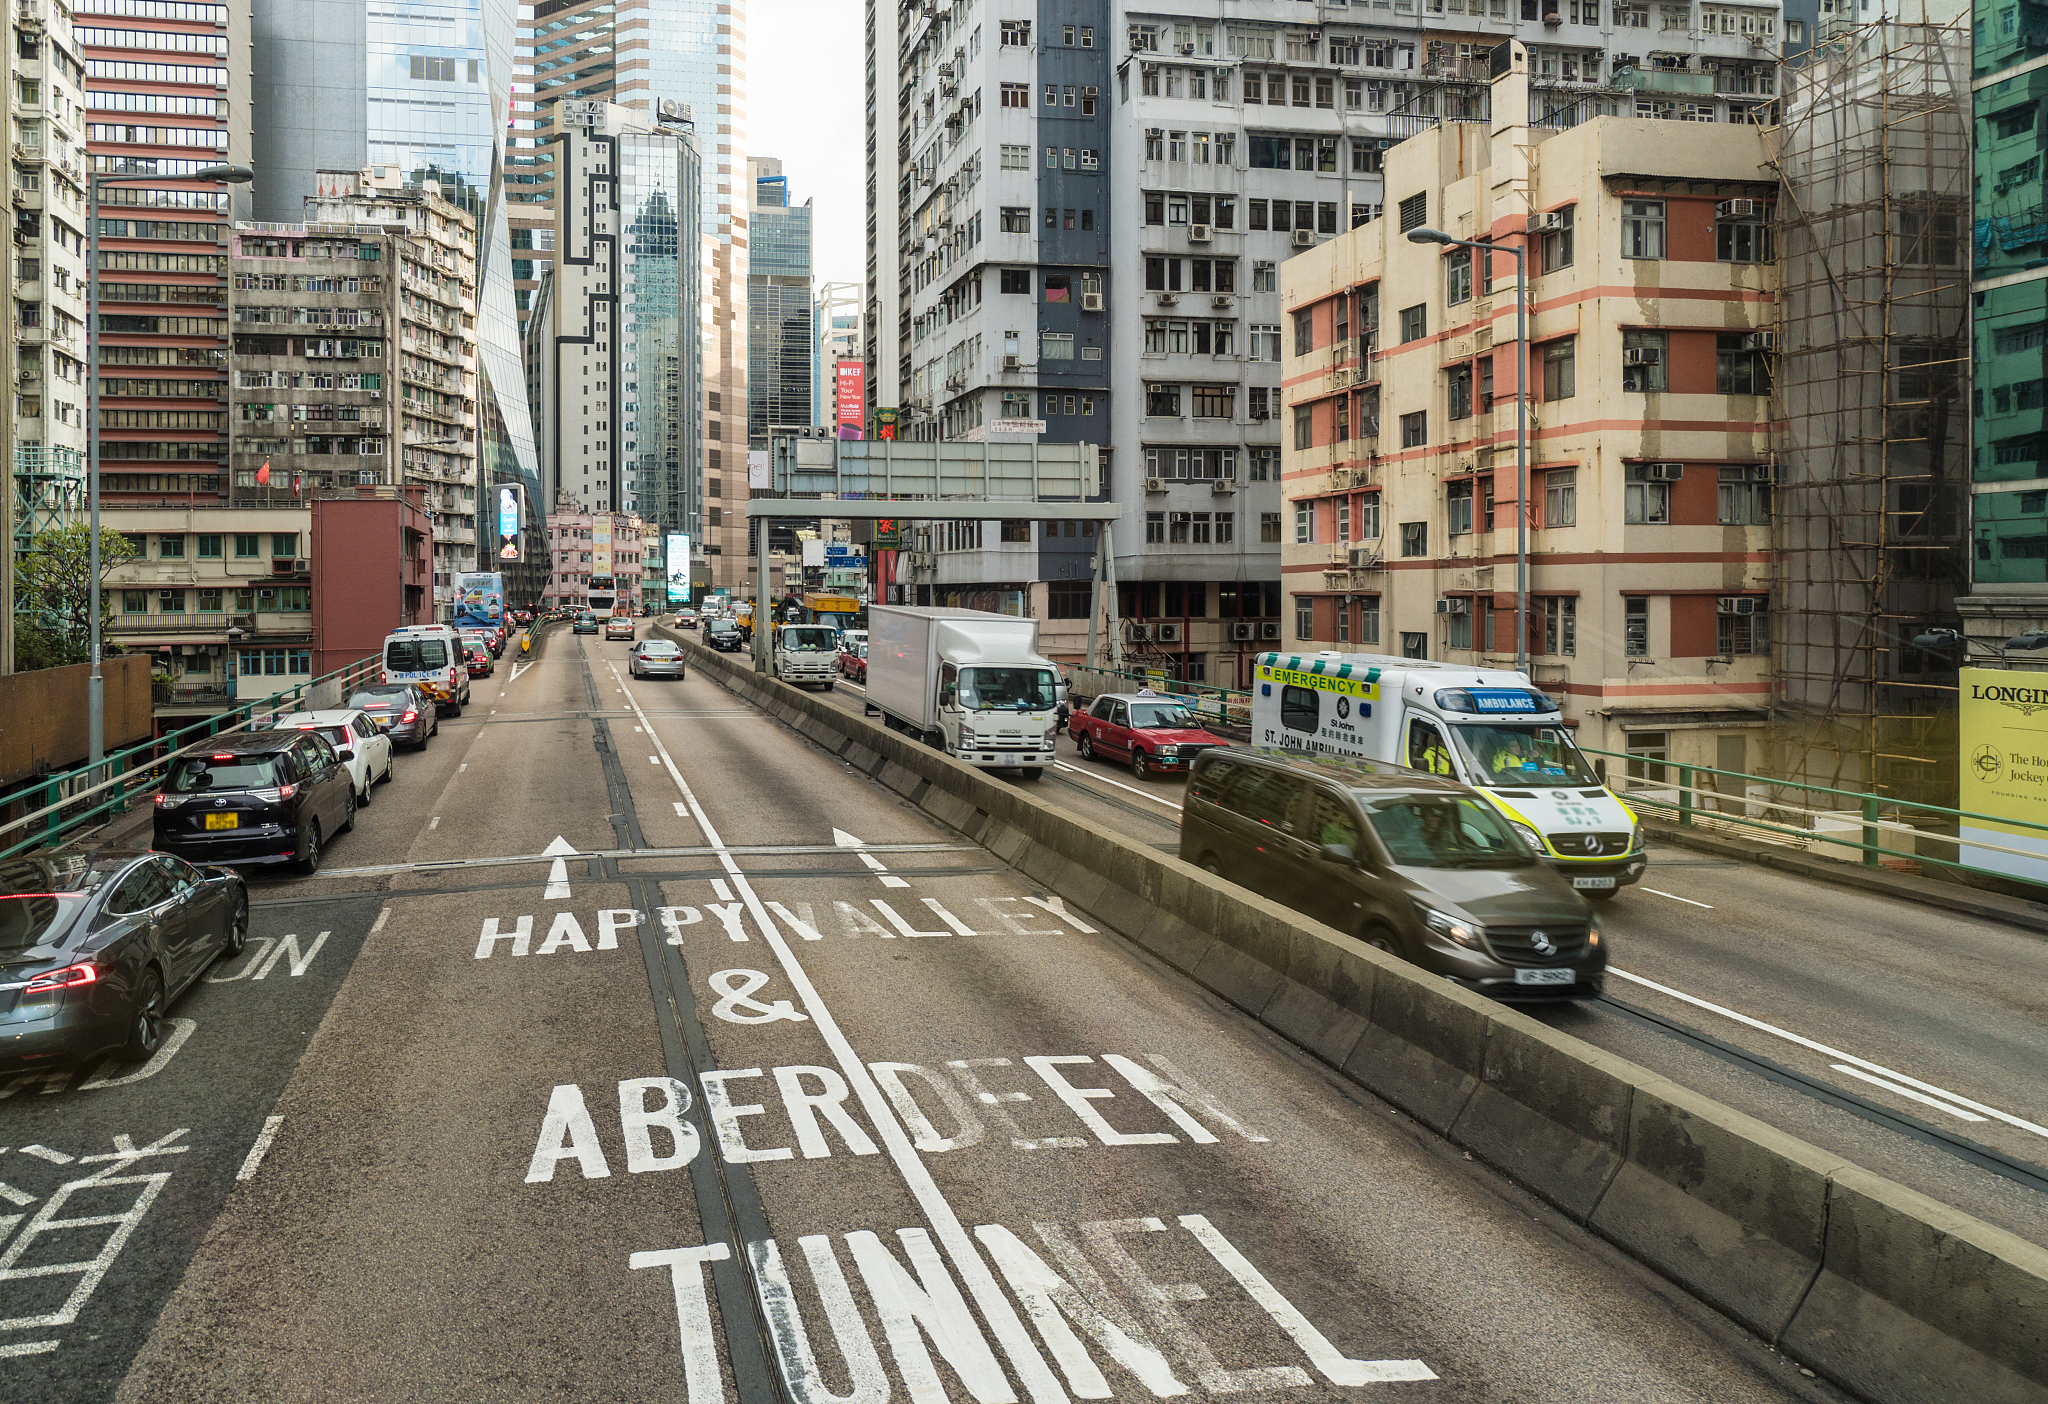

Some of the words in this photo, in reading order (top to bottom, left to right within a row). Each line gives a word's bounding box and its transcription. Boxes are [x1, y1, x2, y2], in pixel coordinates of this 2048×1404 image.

[564, 100, 604, 114] PLAZA
[564, 112, 605, 127] 2000
[887, 585, 897, 602] DBS
[405, 670, 431, 679] POLICE
[1274, 669, 1356, 694] EMERGENCY
[1477, 698, 1535, 710] AMBULANCE
[1330, 718, 1338, 728] St
[1338, 720, 1355, 731] John
[1264, 728, 1277, 745] ST.
[1279, 732, 1303, 750] JOHN
[2009, 753, 2029, 765] The
[2032, 755, 2048, 767] Ho
[2009, 769, 2046, 786] Jockey
[1991, 790, 2029, 800] FOUNDING
[474, 902, 751, 960] HAPPY
[763, 895, 1101, 941] VALLEY
[707, 968, 810, 1026] &
[523, 1053, 1271, 1185] ABERDEEN
[629, 1213, 1441, 1404] TUNNEL
